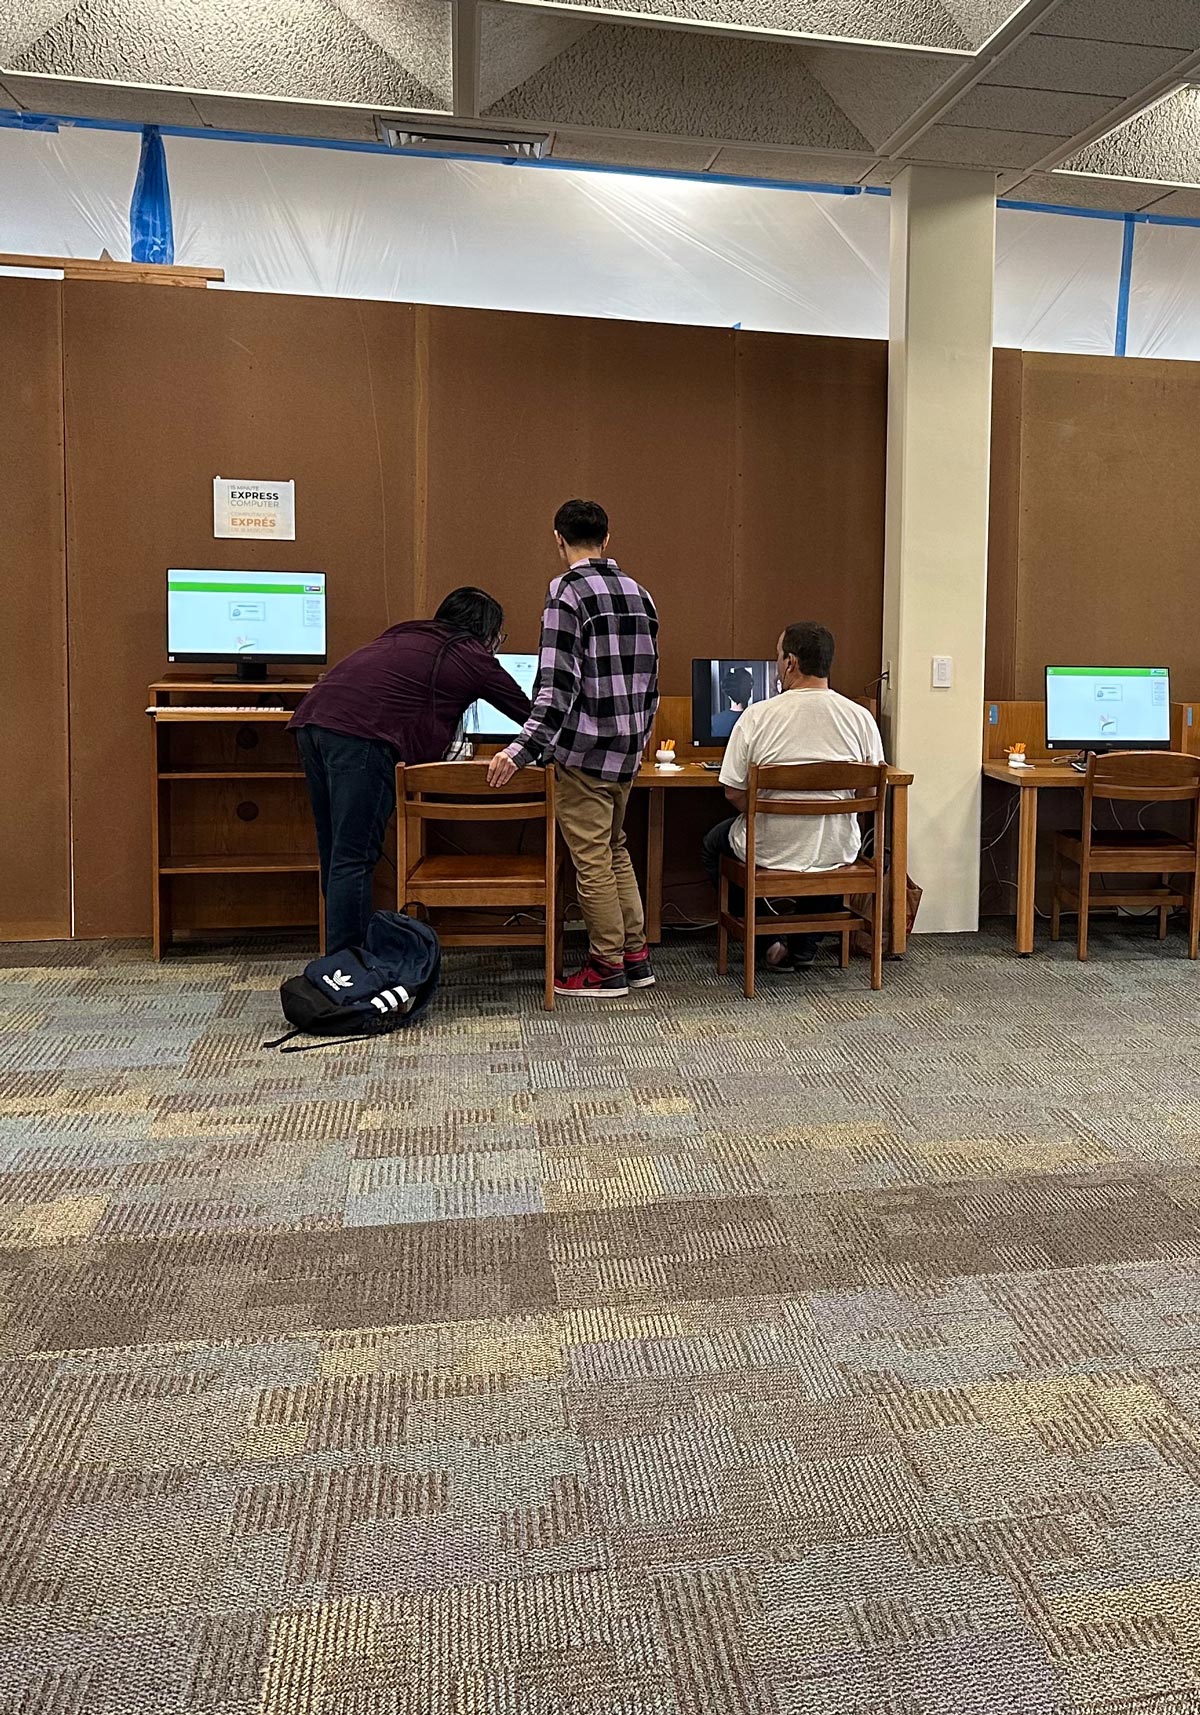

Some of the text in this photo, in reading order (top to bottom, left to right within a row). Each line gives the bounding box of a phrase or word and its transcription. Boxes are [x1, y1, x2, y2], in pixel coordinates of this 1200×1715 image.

[231, 491, 279, 500] EXPRESS
[230, 499, 280, 508] COMPUTER
[231, 516, 276, 528] EXPRÉS
